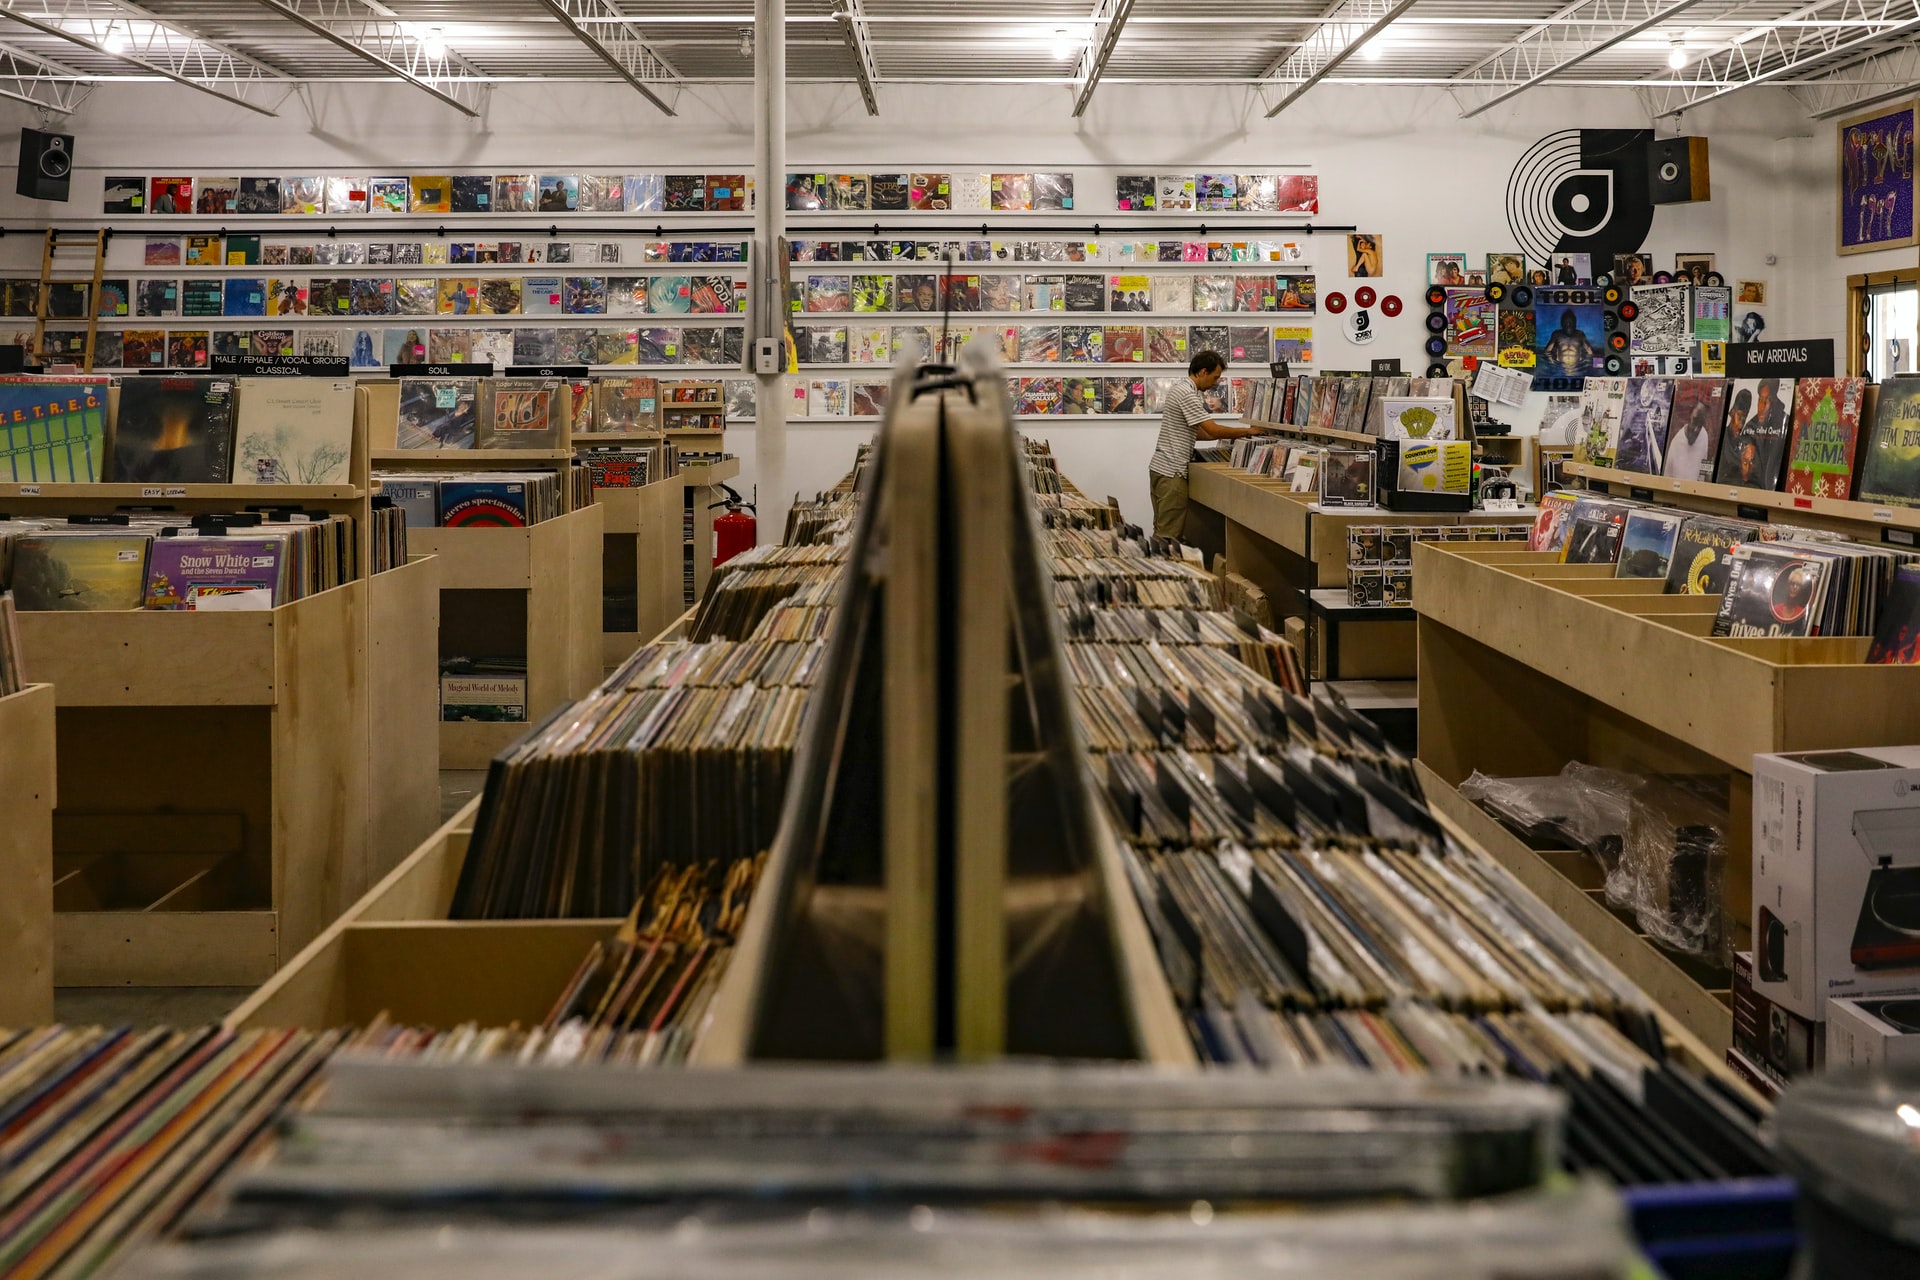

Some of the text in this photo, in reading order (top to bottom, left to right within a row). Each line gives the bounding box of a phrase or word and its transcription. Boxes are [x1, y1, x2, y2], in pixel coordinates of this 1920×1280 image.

[1540, 290, 1602, 304] TOOL
[1355, 330, 1373, 339] JOSEY
[215, 356, 237, 364] MALE
[281, 357, 310, 365] VOCAL
[313, 357, 347, 365] GROUPS
[1747, 348, 1808, 364] NEW ARRIVALS
[255, 367, 302, 375] CLASSICAL
[428, 366, 450, 376] SOUL
[540, 368, 554, 376] CDs
[1404, 448, 1437, 459] COUNTER-TOP
[443, 497, 526, 522] stereo spectacular
[180, 555, 250, 568] Snow White
[204, 567, 223, 575] Seven
[224, 566, 247, 575] Dwarfs
[1719, 577, 1738, 618] Knives
[447, 683, 519, 695] Magical World of Melody
